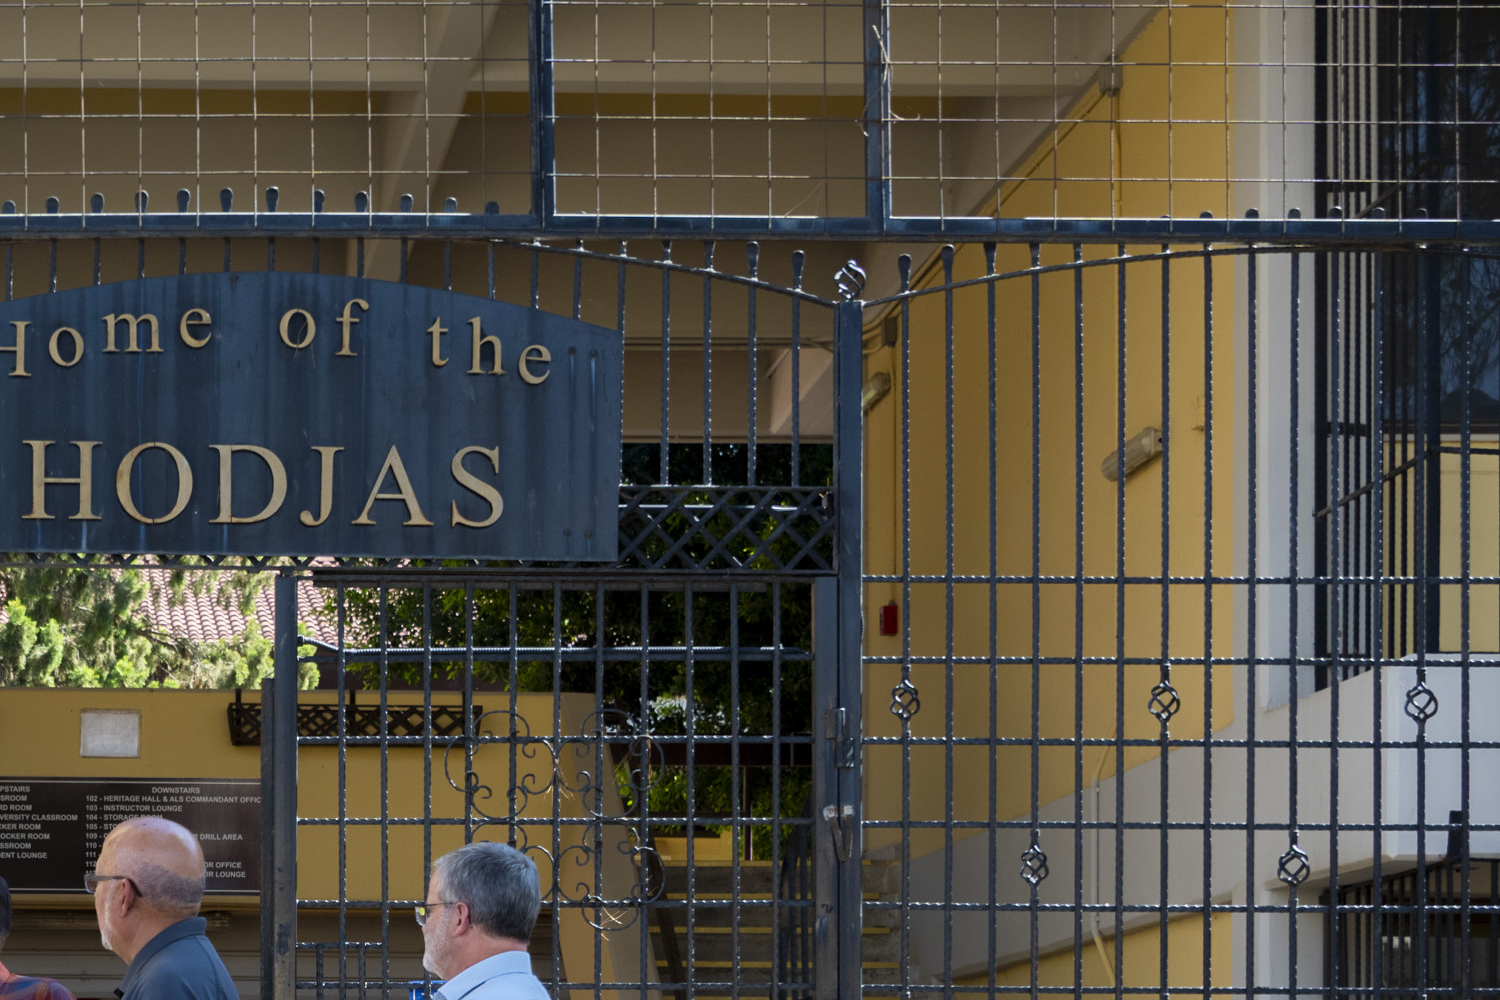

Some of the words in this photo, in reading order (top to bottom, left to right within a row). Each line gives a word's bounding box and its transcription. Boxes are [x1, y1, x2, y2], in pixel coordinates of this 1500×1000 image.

[278, 298, 370, 358] of
[427, 316, 552, 385] the
[21, 439, 504, 529] HODJAS
